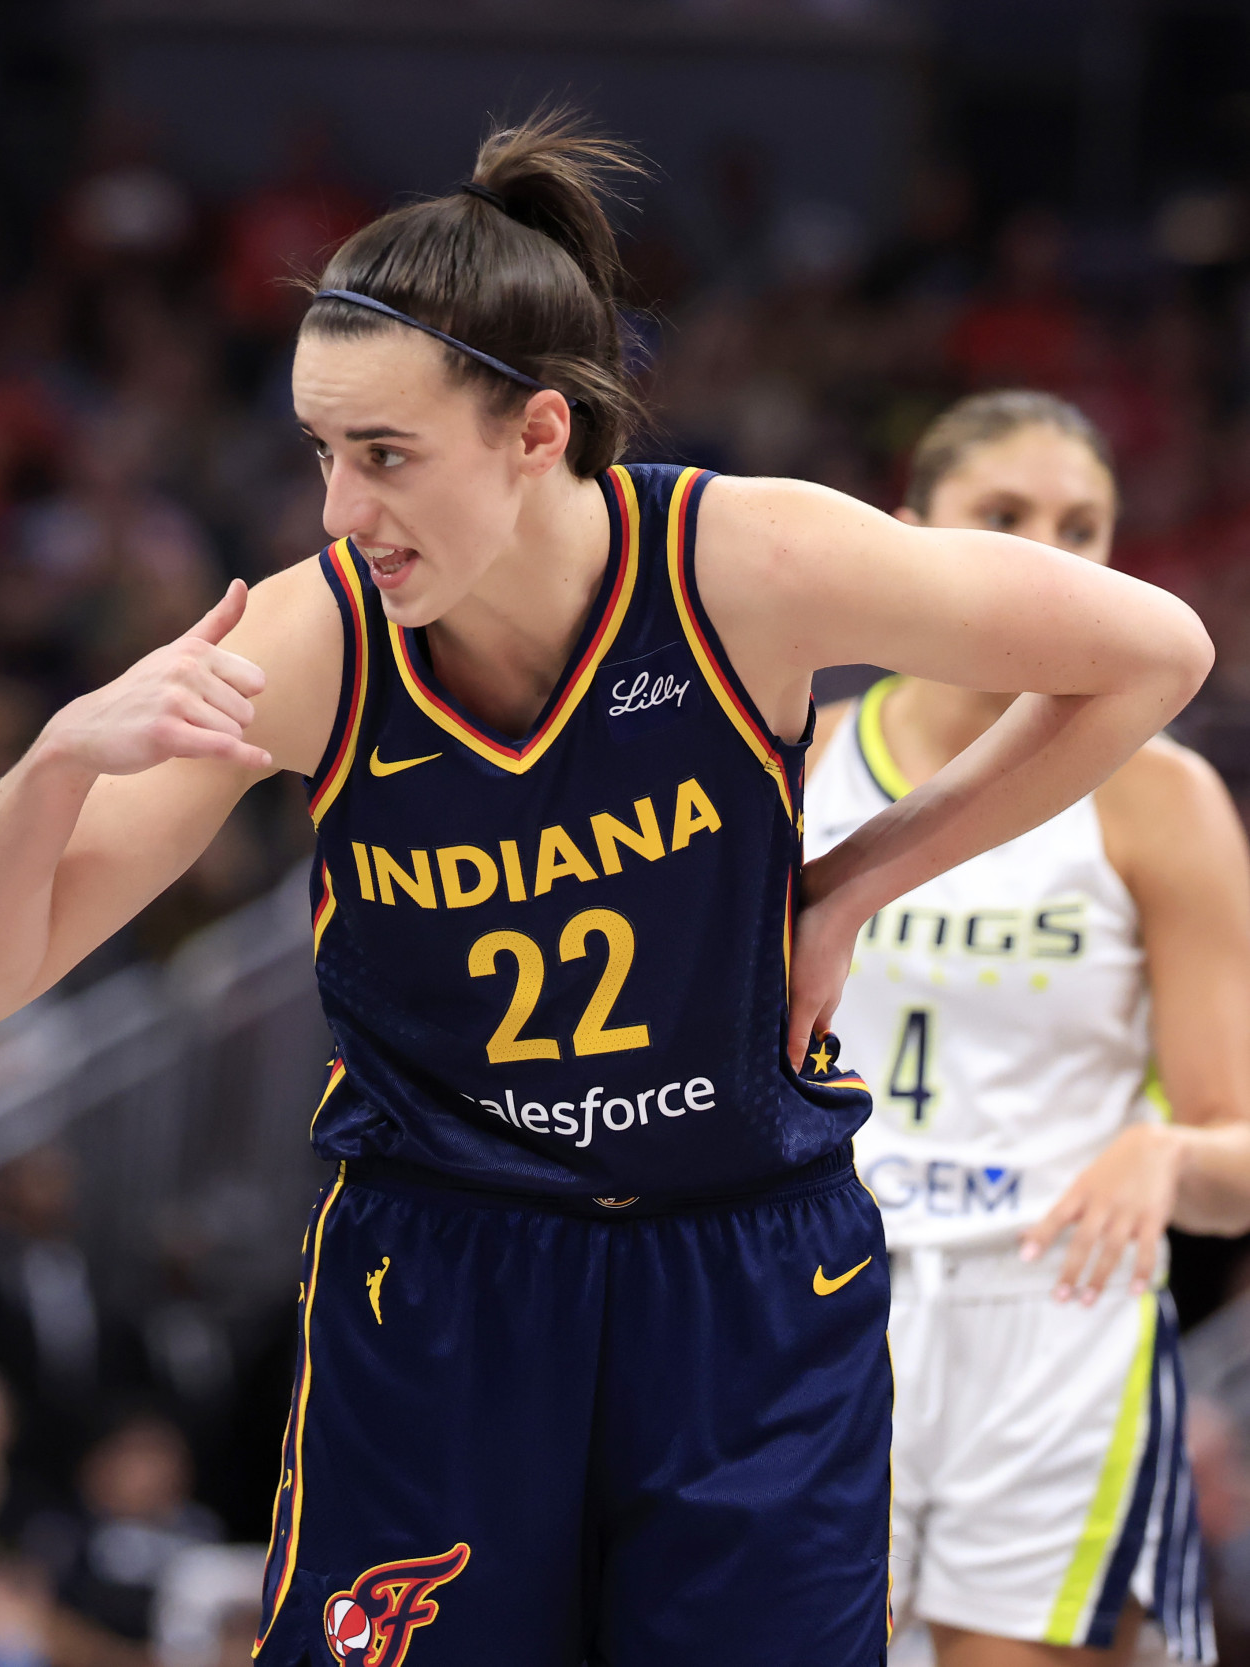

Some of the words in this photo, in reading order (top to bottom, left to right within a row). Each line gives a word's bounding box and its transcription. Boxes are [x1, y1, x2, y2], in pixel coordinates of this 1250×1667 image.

[608, 671, 691, 717] Lilly
[351, 777, 723, 910] INDIANA
[865, 905, 1086, 959] INGS
[467, 908, 651, 1064] 22
[459, 1076, 716, 1148] alesforce
[887, 1006, 937, 1126] 4
